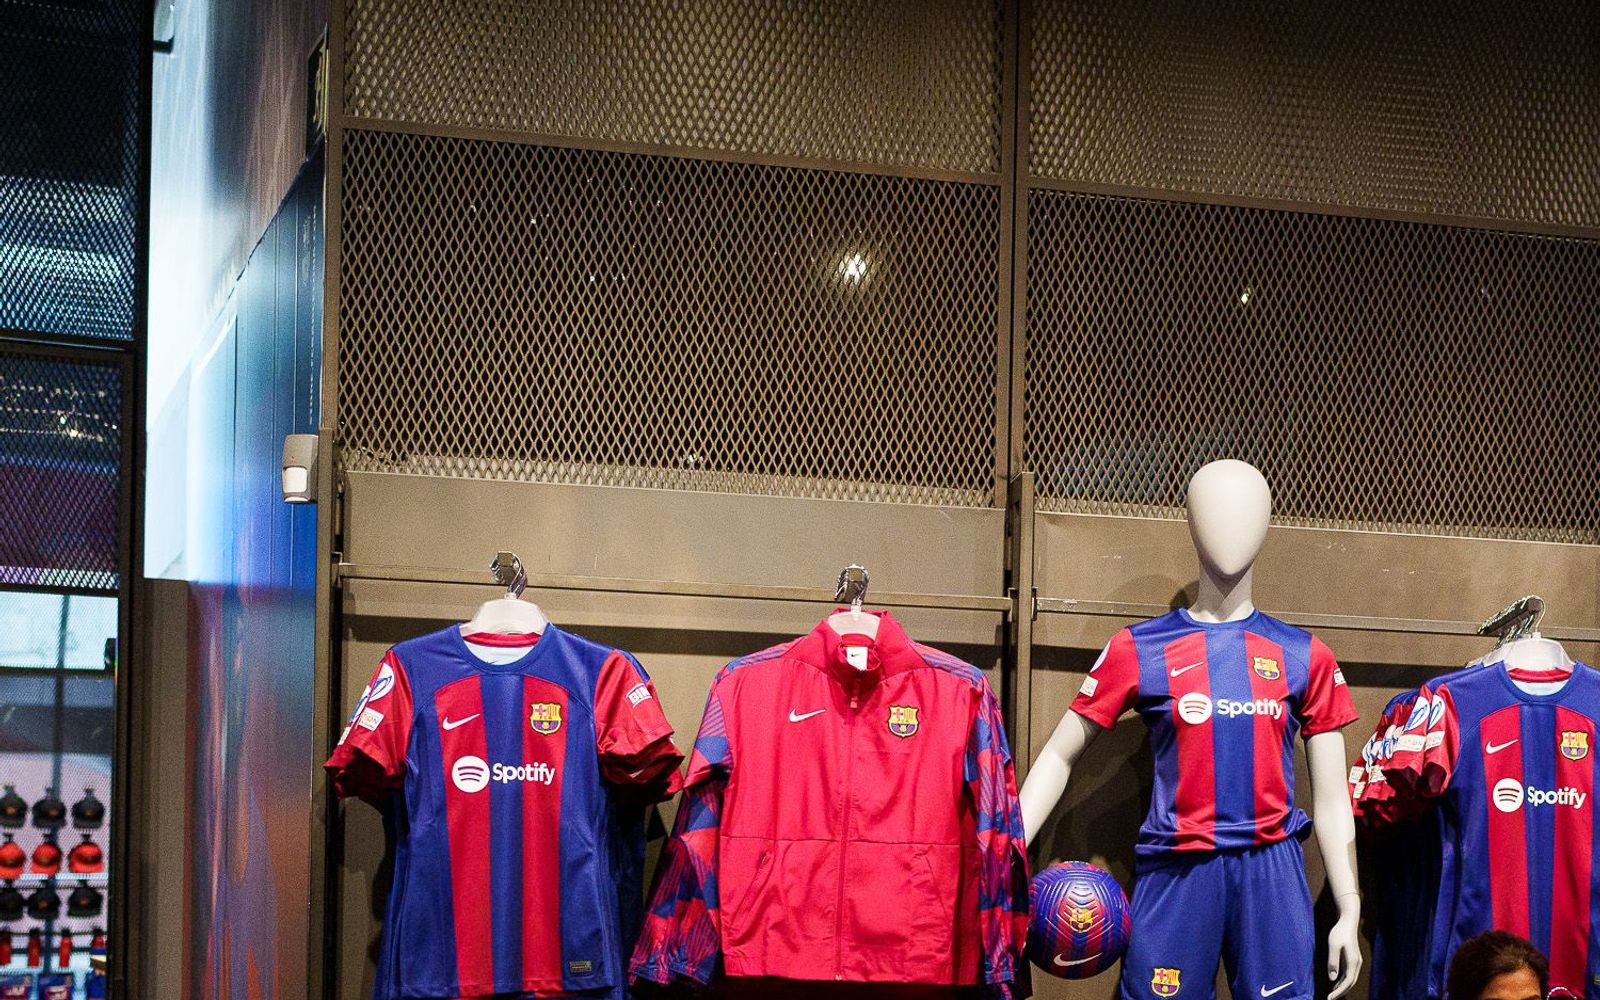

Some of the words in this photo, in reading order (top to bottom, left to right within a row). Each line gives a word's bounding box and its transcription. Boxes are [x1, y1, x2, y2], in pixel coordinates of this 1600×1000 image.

[1217, 698, 1283, 720] Spotify
[492, 762, 555, 785] Spotify
[1527, 786, 1587, 809] Spotify
